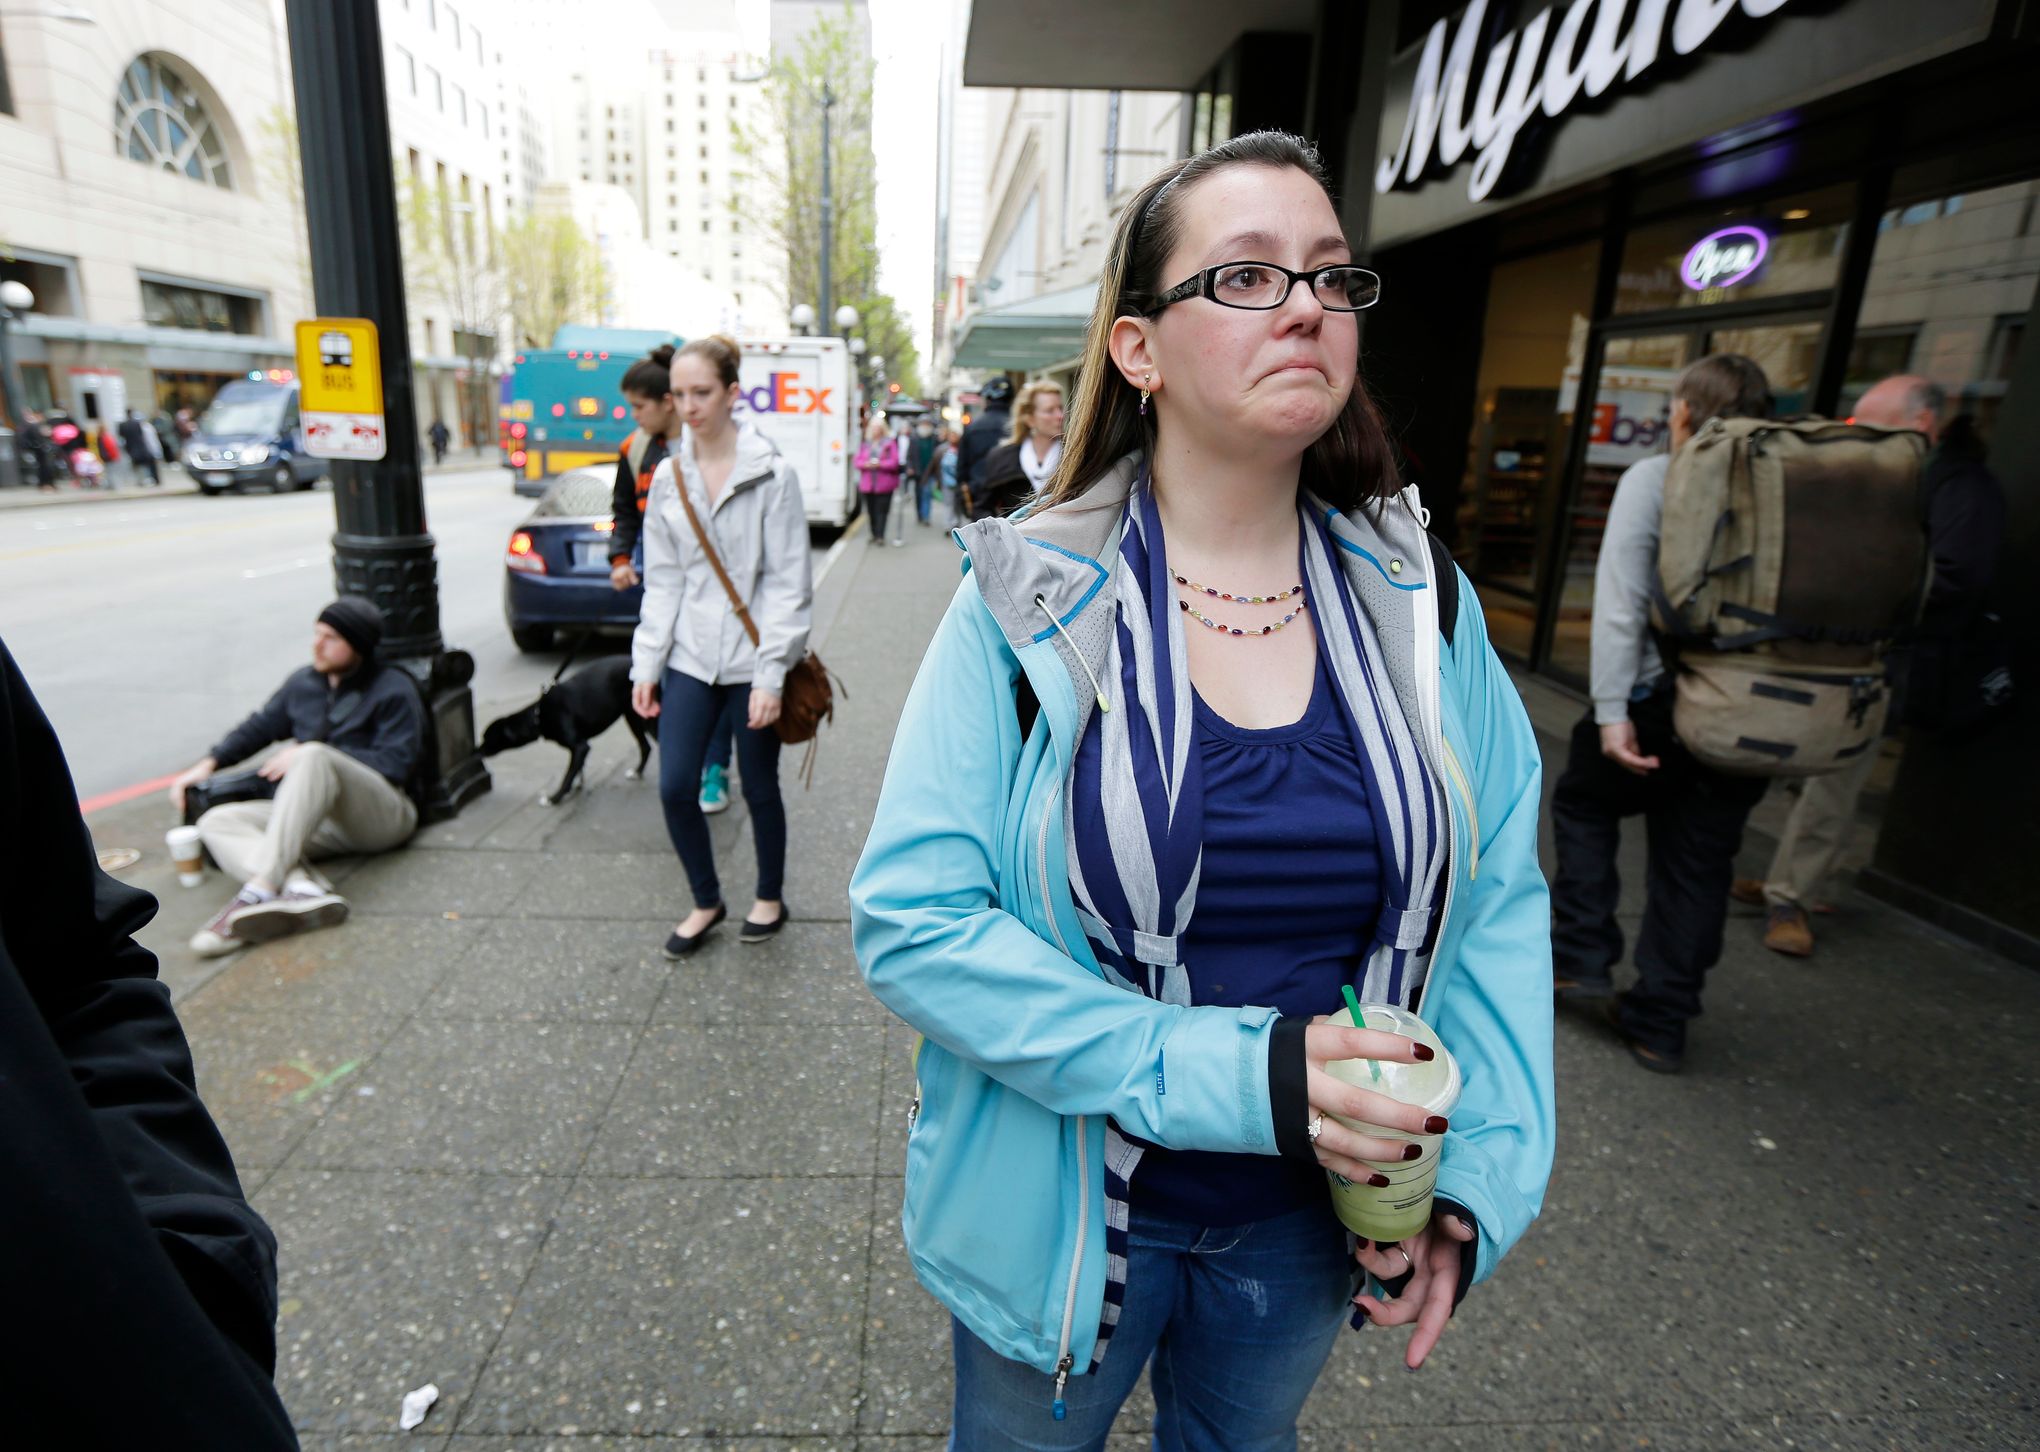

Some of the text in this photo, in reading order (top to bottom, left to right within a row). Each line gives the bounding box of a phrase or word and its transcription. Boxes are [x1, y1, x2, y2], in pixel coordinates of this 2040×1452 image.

[1687, 239, 1755, 287] Open
[322, 374, 355, 391] BUS
[732, 372, 832, 414] dEx
